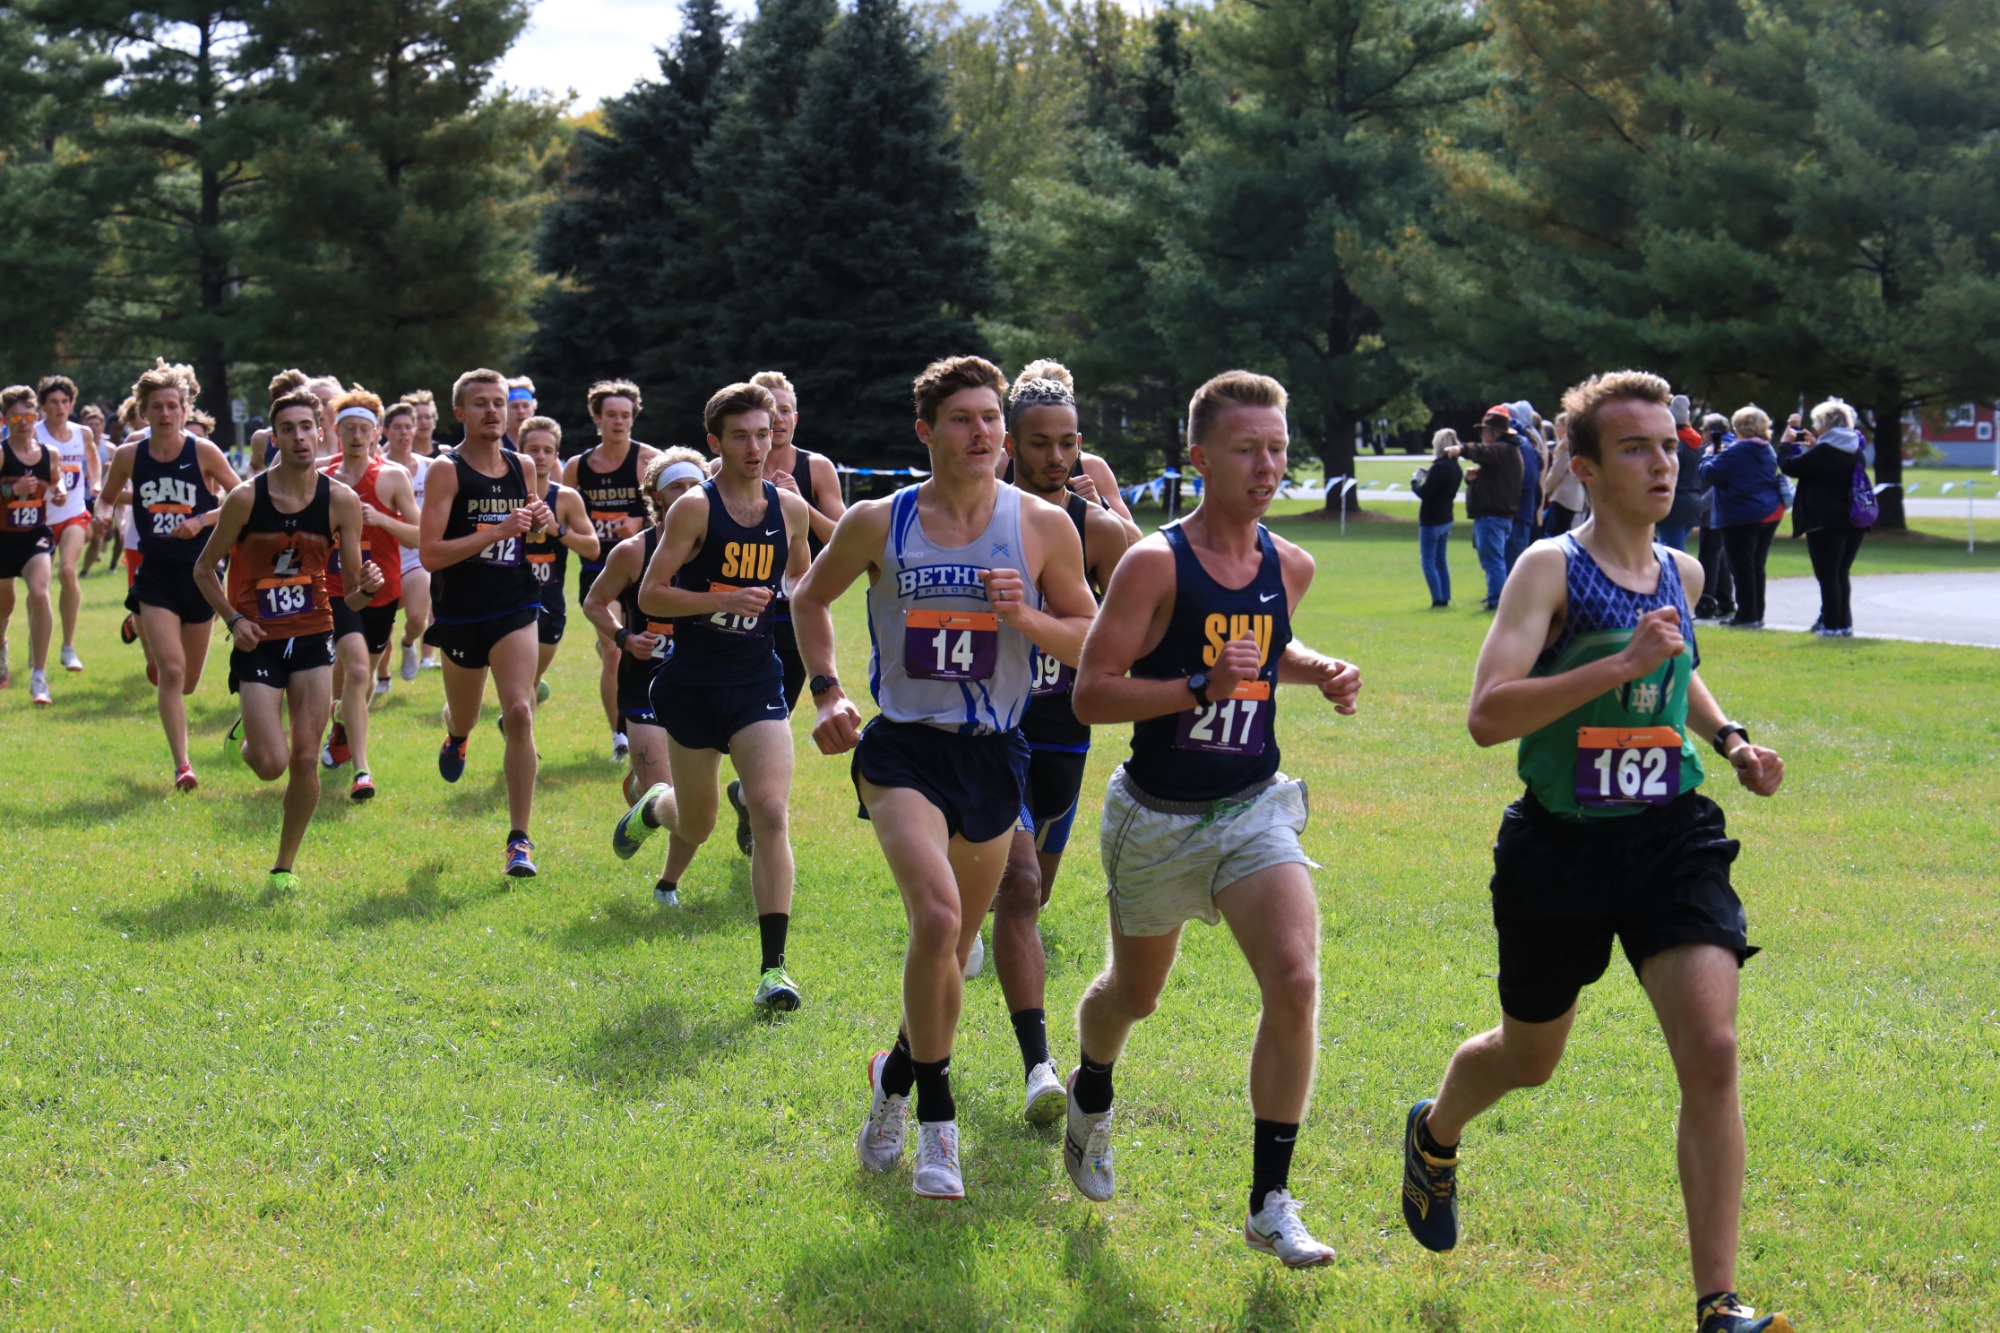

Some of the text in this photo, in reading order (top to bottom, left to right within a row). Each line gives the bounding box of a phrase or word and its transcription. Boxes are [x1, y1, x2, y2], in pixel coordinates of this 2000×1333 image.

[140, 477, 197, 508] SAU
[583, 487, 636, 501] URDUE
[13, 507, 38, 525] 129
[480, 537, 515, 560] 212
[721, 541, 774, 580] SHU
[267, 585, 305, 613] 133
[925, 587, 978, 595] PILOTS
[932, 629, 974, 672] 14
[1189, 699, 1259, 745] 217
[1593, 747, 1667, 797] 162
